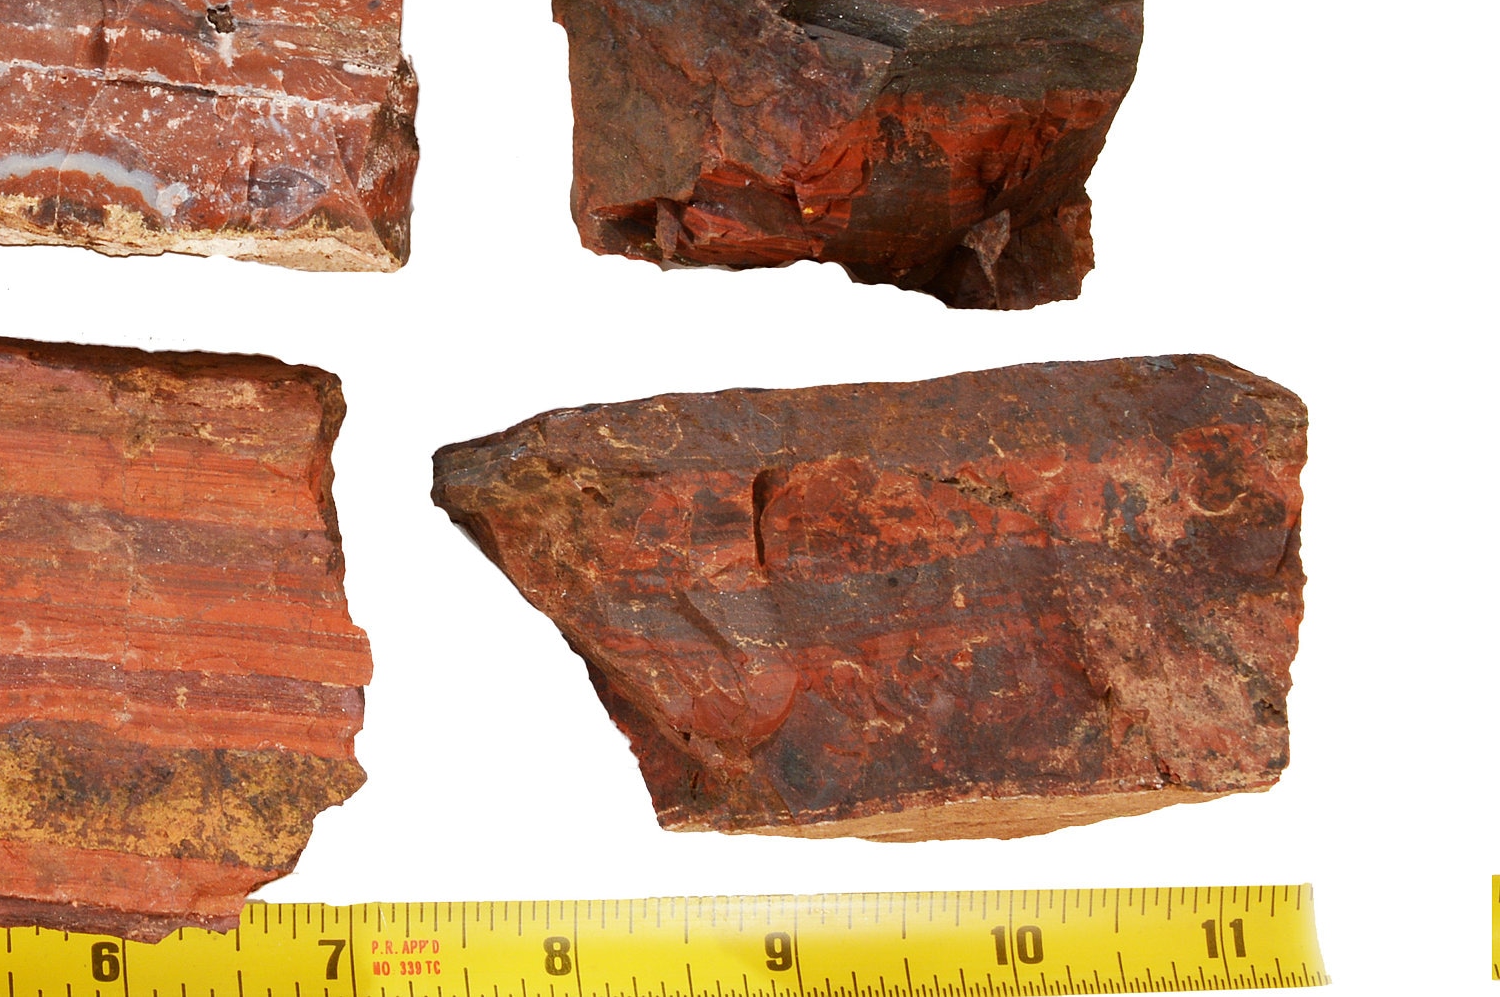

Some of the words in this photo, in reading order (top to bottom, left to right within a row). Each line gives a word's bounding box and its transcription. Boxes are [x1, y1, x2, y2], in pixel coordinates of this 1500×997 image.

[543, 936, 572, 977] 8
[764, 932, 794, 972] 9
[990, 924, 1045, 966] 10
[1201, 918, 1247, 959] 11
[90, 941, 121, 982] 6
[317, 939, 348, 981] 7
[400, 960, 422, 976] 339
[425, 959, 441, 976] TC
